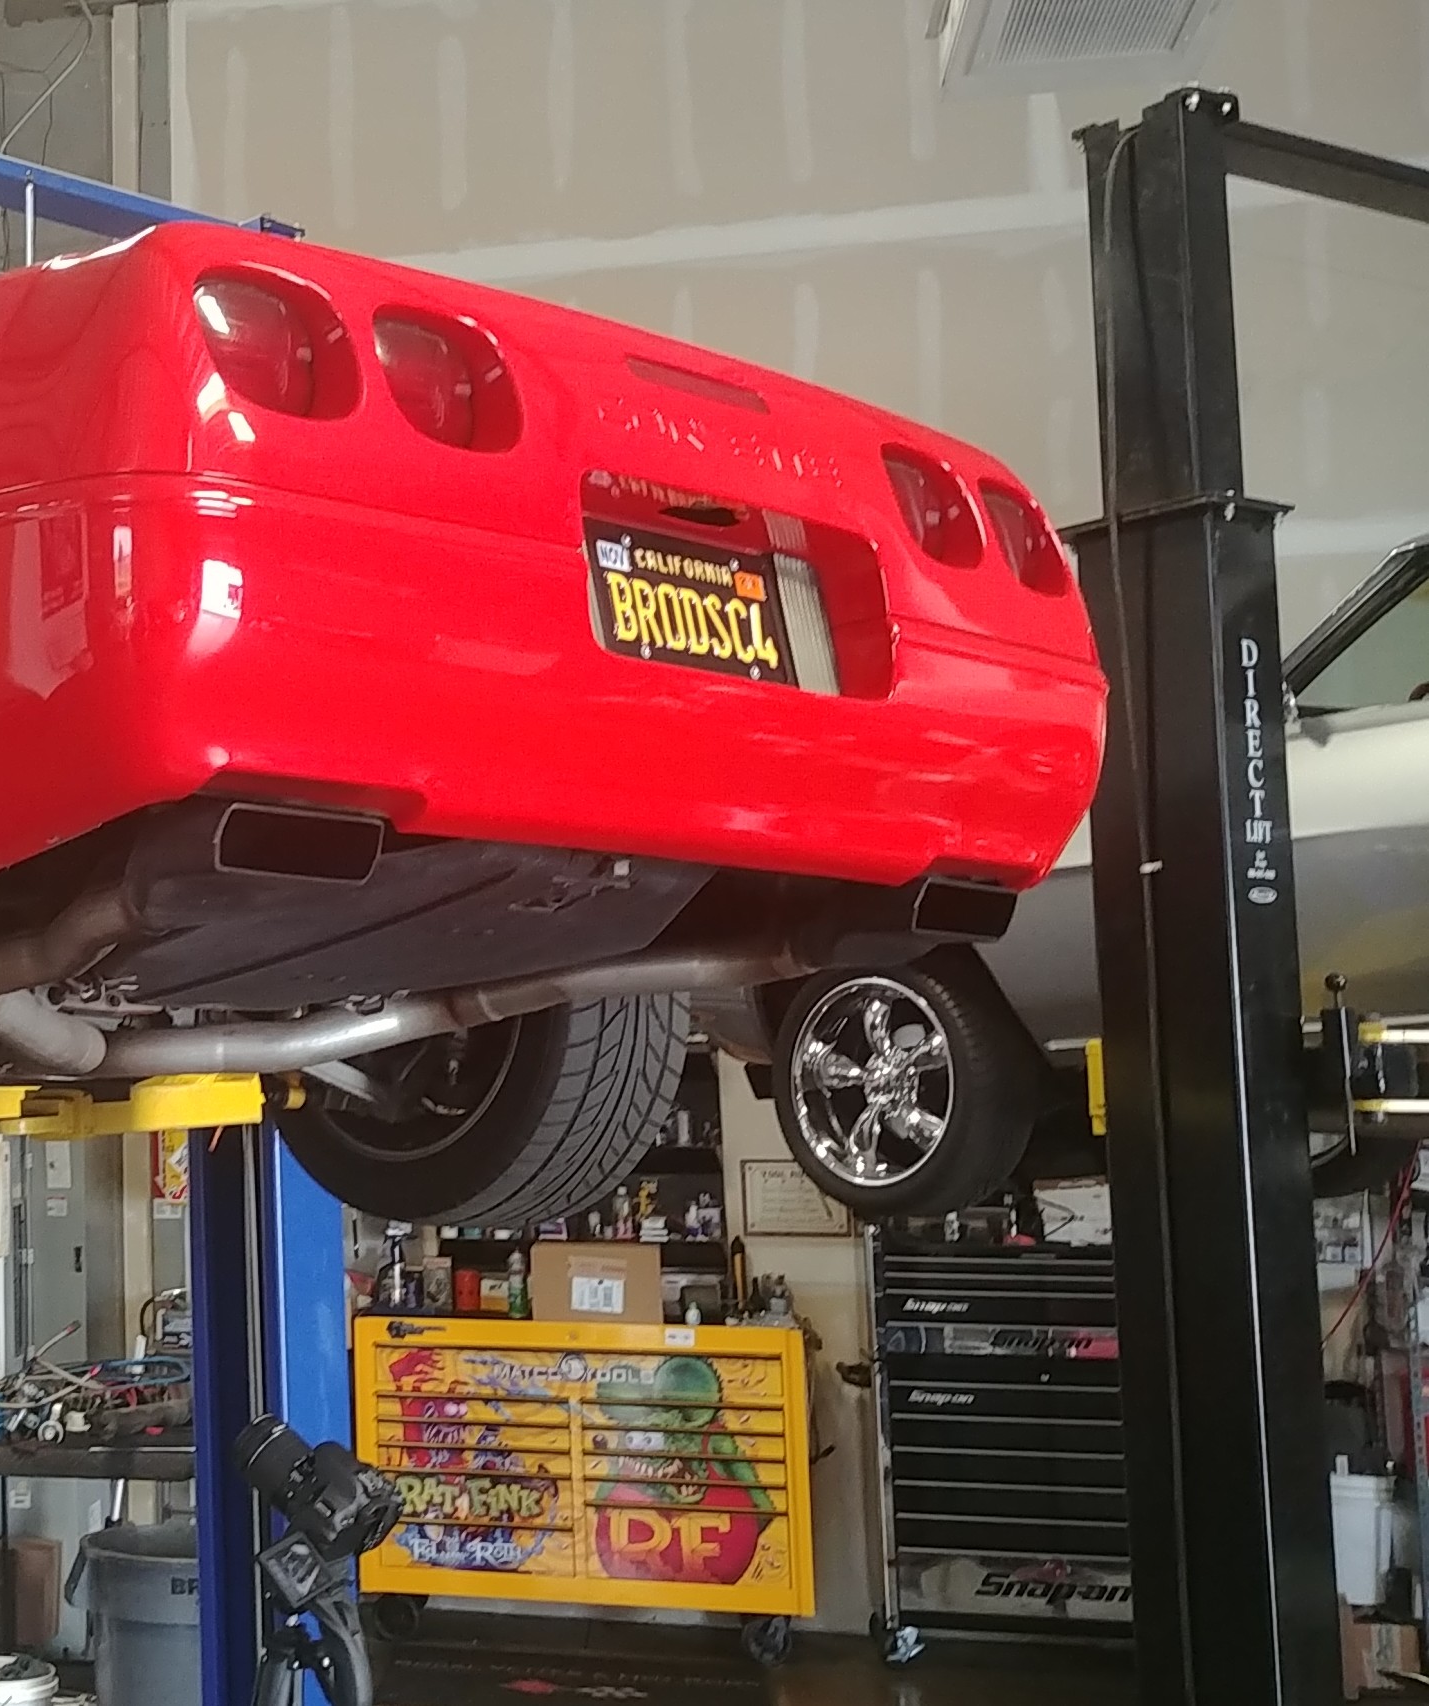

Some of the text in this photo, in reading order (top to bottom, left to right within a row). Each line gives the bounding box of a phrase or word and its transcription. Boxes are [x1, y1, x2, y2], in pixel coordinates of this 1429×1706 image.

[634, 547, 733, 588] CALIFORNIA
[1240, 638, 1266, 818] DIRECT
[1245, 819, 1273, 844] LIFT
[585, 1367, 654, 1385] TOOLS
[395, 1475, 460, 1514] RAT
[974, 1572, 1131, 1606] Snap-on
